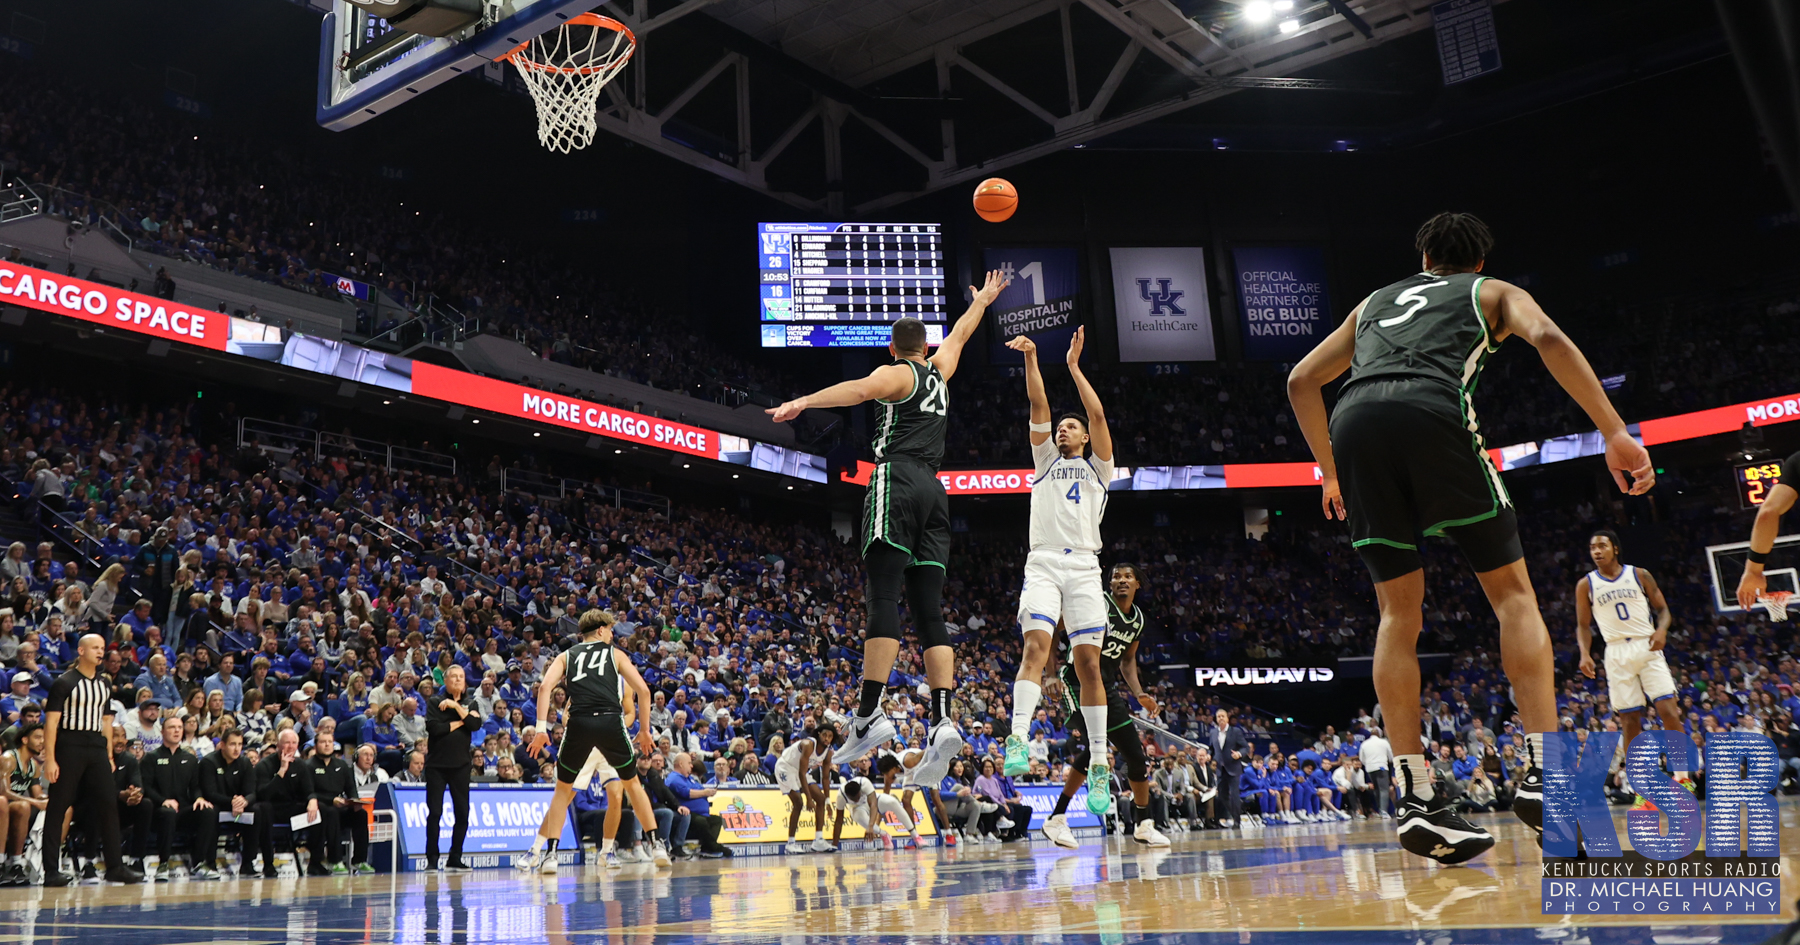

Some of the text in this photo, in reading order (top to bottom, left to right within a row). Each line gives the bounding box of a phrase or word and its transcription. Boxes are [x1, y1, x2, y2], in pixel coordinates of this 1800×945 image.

[769, 256, 782, 268] 26
[763, 273, 788, 281] 10:53
[1242, 271, 1297, 281] OFFICIAL
[771, 285, 783, 297] 16
[1244, 283, 1321, 294] HEALTHCARE
[0, 269, 206, 339] CARGO SPACE
[1136, 278, 1186, 316] UK
[1246, 295, 1318, 306] PARTNER OF
[1378, 281, 1449, 328] 5
[998, 300, 1072, 325] HOSPITAL IN
[1248, 308, 1319, 321] BIG BLUE
[1004, 313, 1069, 336] KENTUCKY
[1132, 320, 1198, 332] HealthCare
[1249, 323, 1312, 336] NATION
[1156, 365, 1180, 374] 236
[920, 374, 946, 416] 21
[523, 393, 706, 451] MORE CARGO SPACE
[1744, 464, 1782, 480] 10:53
[955, 474, 1021, 490] CARGO
[1066, 482, 1081, 504] 4
[1596, 588, 1638, 606] KENTUCKY
[1615, 602, 1630, 621] 0
[1102, 641, 1126, 659] 25
[572, 648, 609, 682] 14
[1021, 795, 1053, 812] ORGAN
[403, 802, 550, 828] MOGN & MORGA
[722, 813, 766, 828] TEXAS
[466, 829, 495, 838] LARGEST
[496, 828, 519, 837] INJURY
[521, 828, 534, 836] LAW
[473, 856, 499, 868] BUREAU
